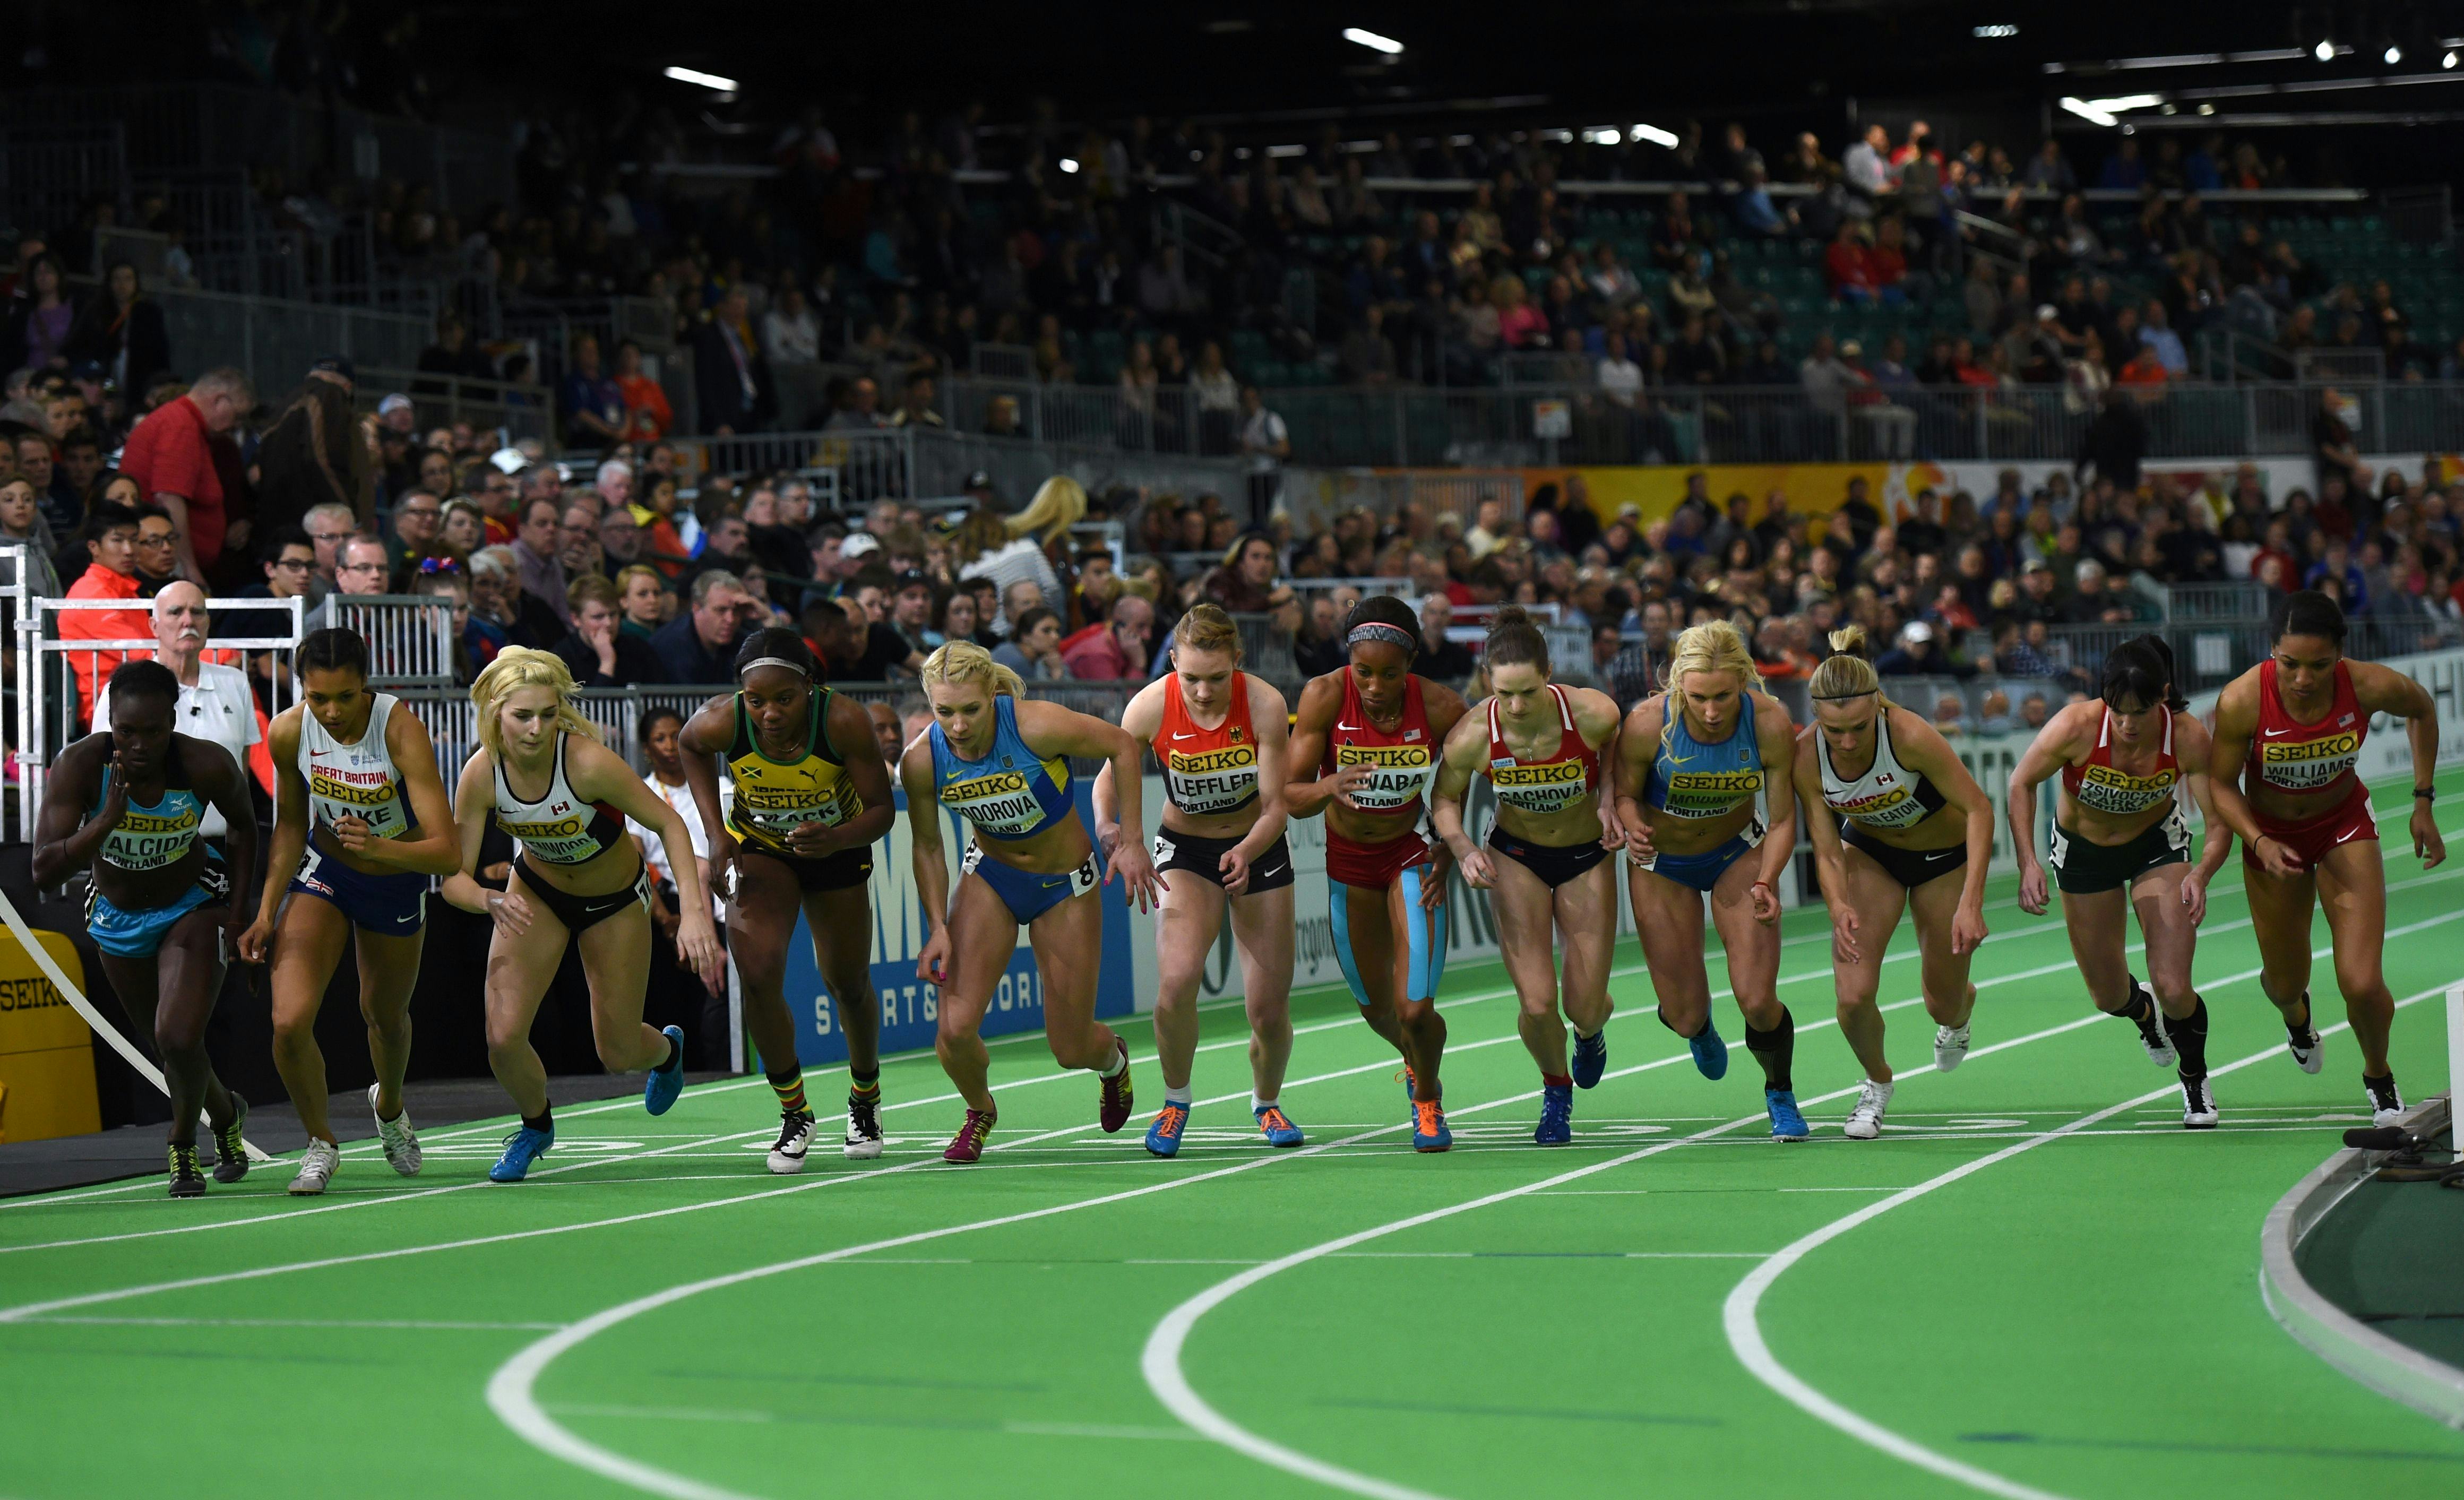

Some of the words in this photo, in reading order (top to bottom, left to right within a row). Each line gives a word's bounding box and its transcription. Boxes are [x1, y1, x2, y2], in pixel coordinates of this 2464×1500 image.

[1340, 749, 1427, 766] SEIKO
[2267, 736, 2355, 761] SEIKO
[1171, 748, 1252, 773] SEIKO
[2267, 757, 2355, 779] WILLIAMS
[311, 764, 343, 781] GREAT
[344, 771, 387, 785] BRITAIN
[1174, 772, 1254, 797] LEFFLER
[1359, 773, 1424, 791] WABA
[1495, 764, 1581, 785] SEIKO
[1673, 774, 1761, 790] SEIKO
[2088, 768, 2172, 790] SEIKO
[313, 777, 393, 805] SEIKO
[944, 774, 1023, 801] SEIKO
[748, 789, 833, 809] SEIKO
[1176, 797, 1236, 813] PORTLAND
[1349, 793, 1403, 807] ORTLAND
[115, 811, 195, 833] SEIKO
[1666, 805, 1728, 818] PORTLAND
[1880, 800, 1920, 822] EATON
[107, 831, 193, 857] ALCIDE
[105, 851, 167, 869] PORTLAND
[1079, 860, 1094, 886] 8
